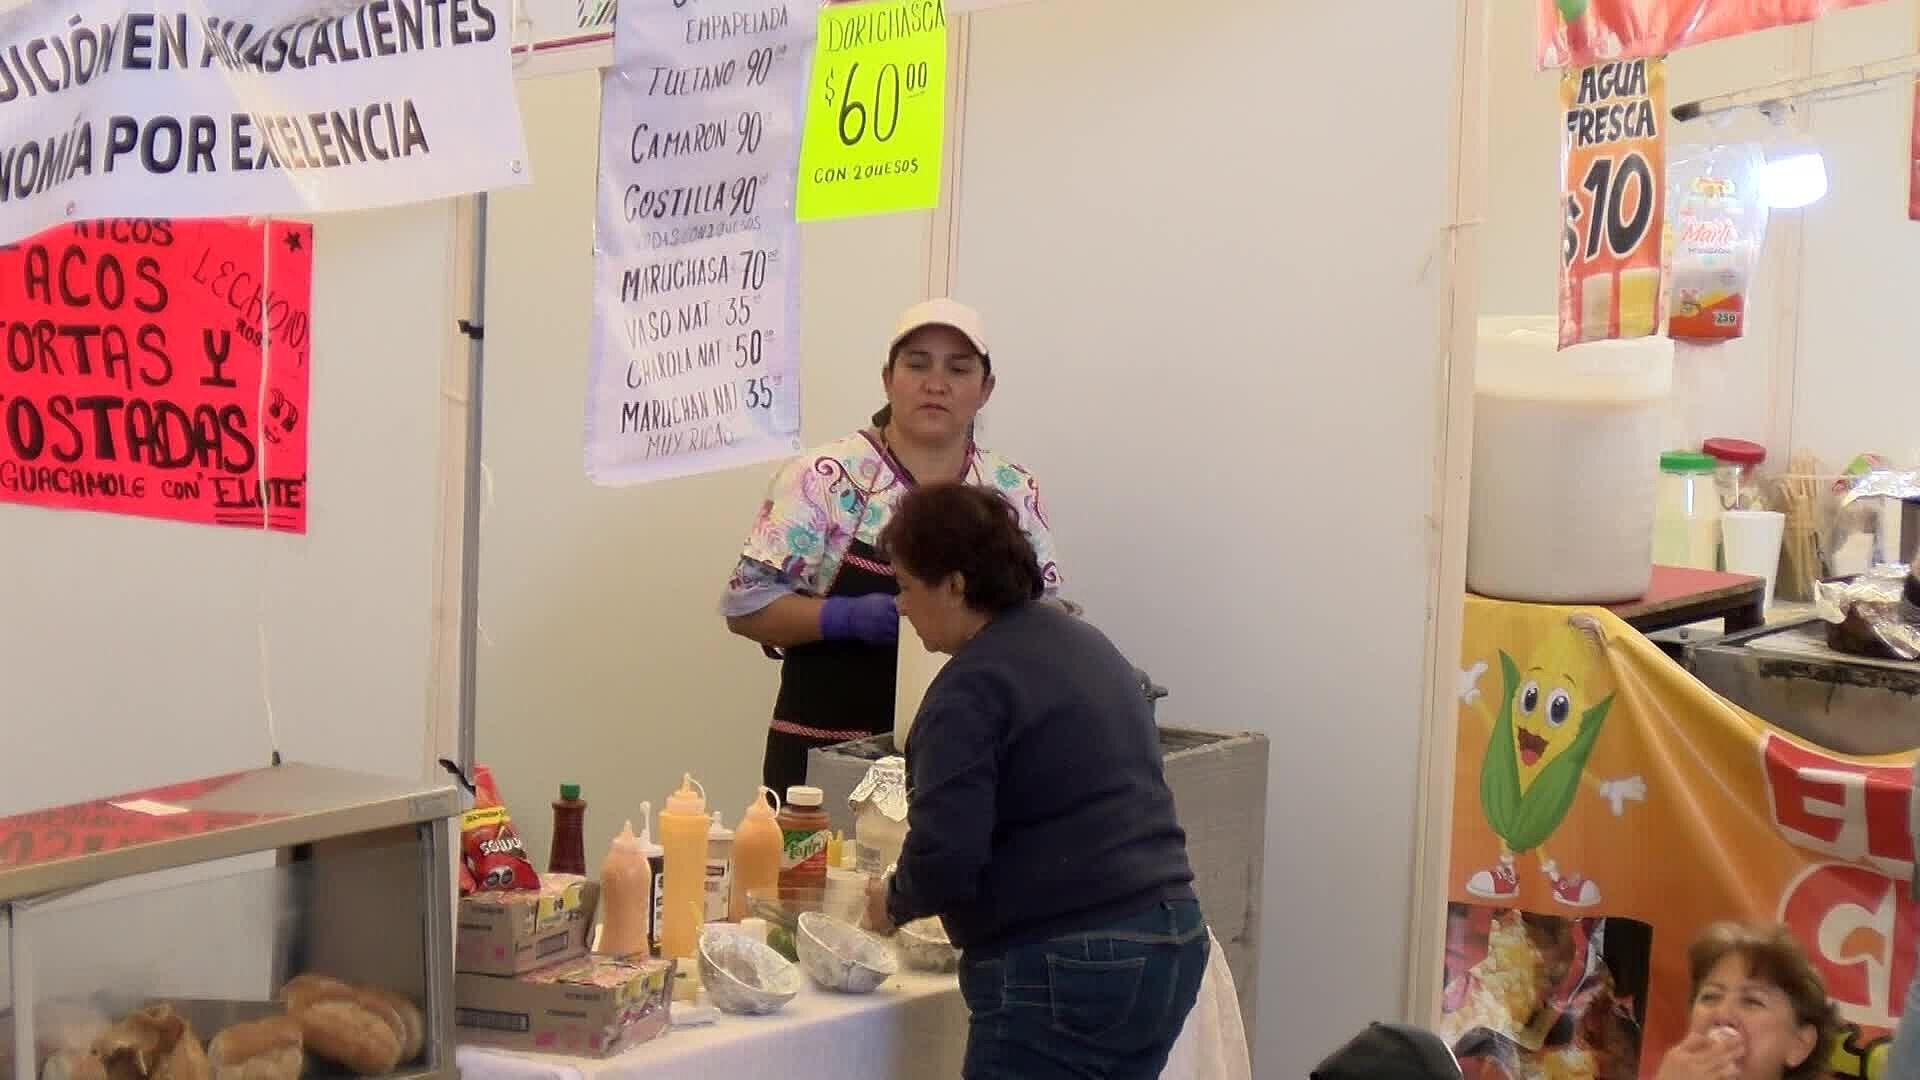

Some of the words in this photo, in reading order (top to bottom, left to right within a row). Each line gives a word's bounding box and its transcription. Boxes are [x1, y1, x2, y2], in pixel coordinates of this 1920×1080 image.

[122, 13, 188, 70] EN
[200, 0, 496, 74] AASCALIENTES
[686, 7, 789, 44] EMPAPELADA
[826, 0, 945, 52] DORICHASCA
[1577, 58, 1647, 105] AGUA
[103, 115, 216, 174] POR
[631, 122, 727, 164] CAMARON
[1567, 99, 1657, 148] FRESCA
[814, 167, 846, 184] CON
[623, 183, 727, 223] COSTILLA
[1563, 151, 1654, 268] $10
[0, 244, 169, 314] ACOS
[621, 255, 729, 304] MARUCHASA
[625, 310, 672, 350] VASO
[677, 299, 712, 332] NAT
[0, 318, 174, 391] ORTAS
[199, 327, 237, 388] Y
[626, 347, 693, 390] CHAROLA
[698, 338, 722, 369] NAT
[620, 391, 710, 434] MARUCHAN
[712, 381, 738, 416] NAT
[0, 394, 257, 475] OSTADAS
[0, 459, 145, 499] GUACAMOLE
